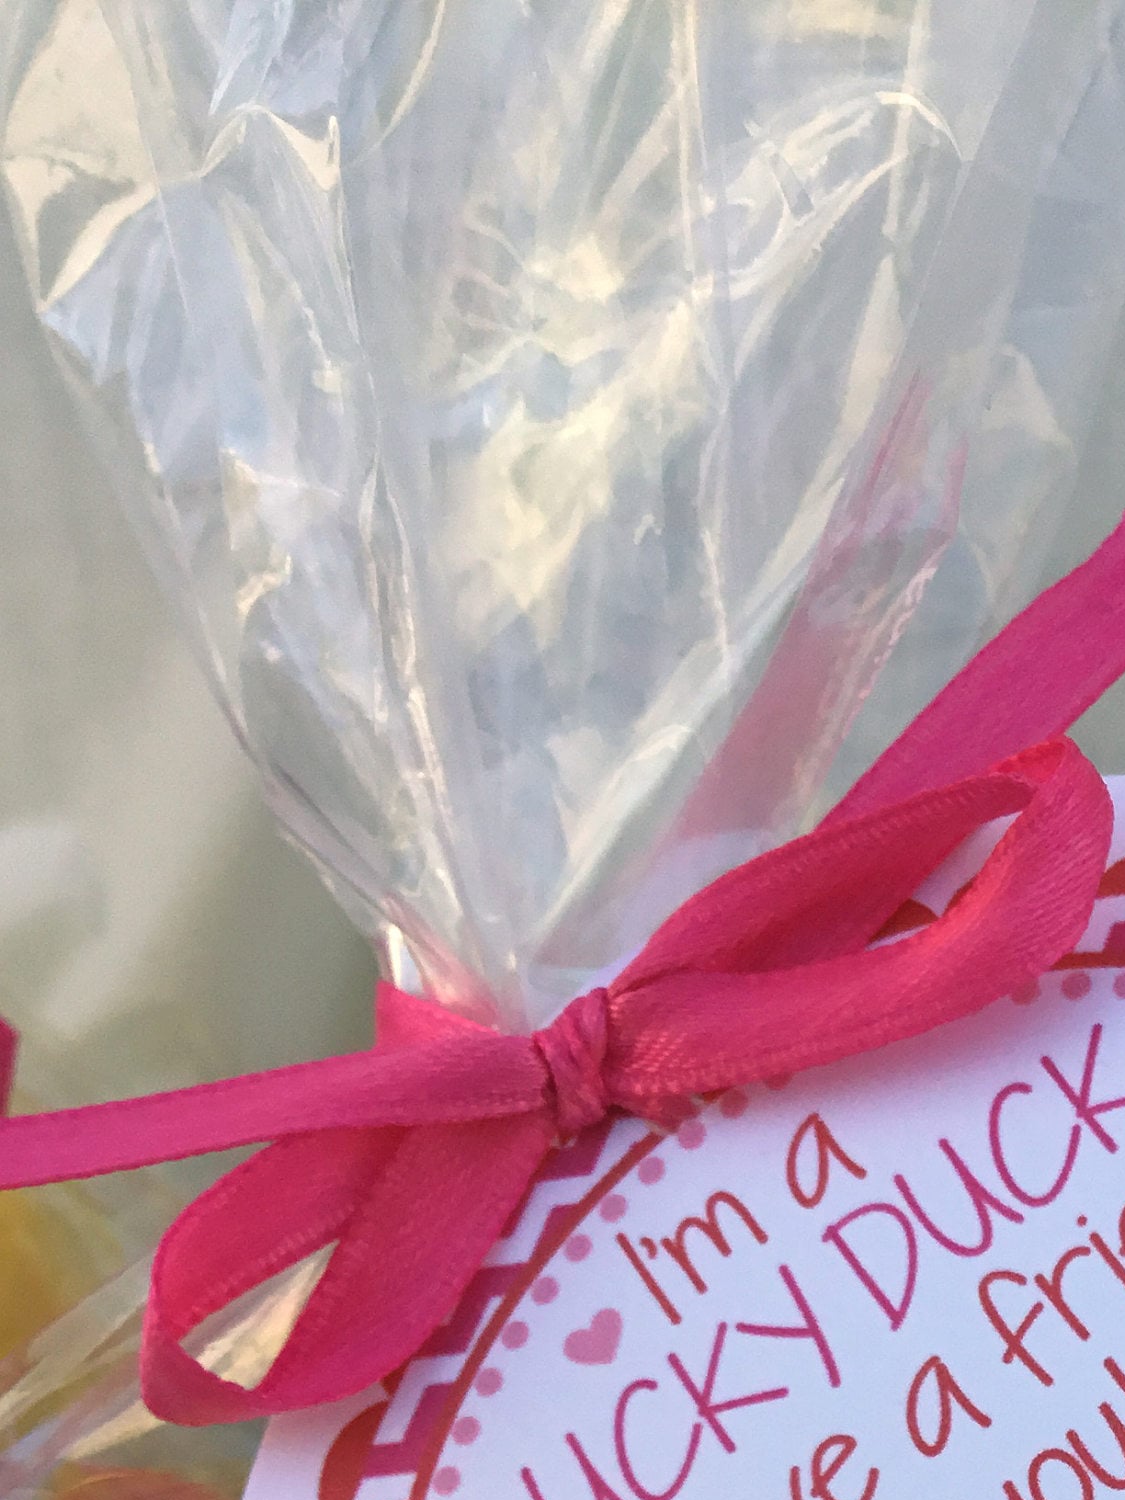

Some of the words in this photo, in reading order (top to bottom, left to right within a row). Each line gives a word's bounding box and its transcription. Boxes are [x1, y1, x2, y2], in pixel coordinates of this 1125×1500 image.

[616, 1190, 768, 1325] I'm
[785, 1113, 867, 1208] a
[905, 1355, 991, 1456] a
